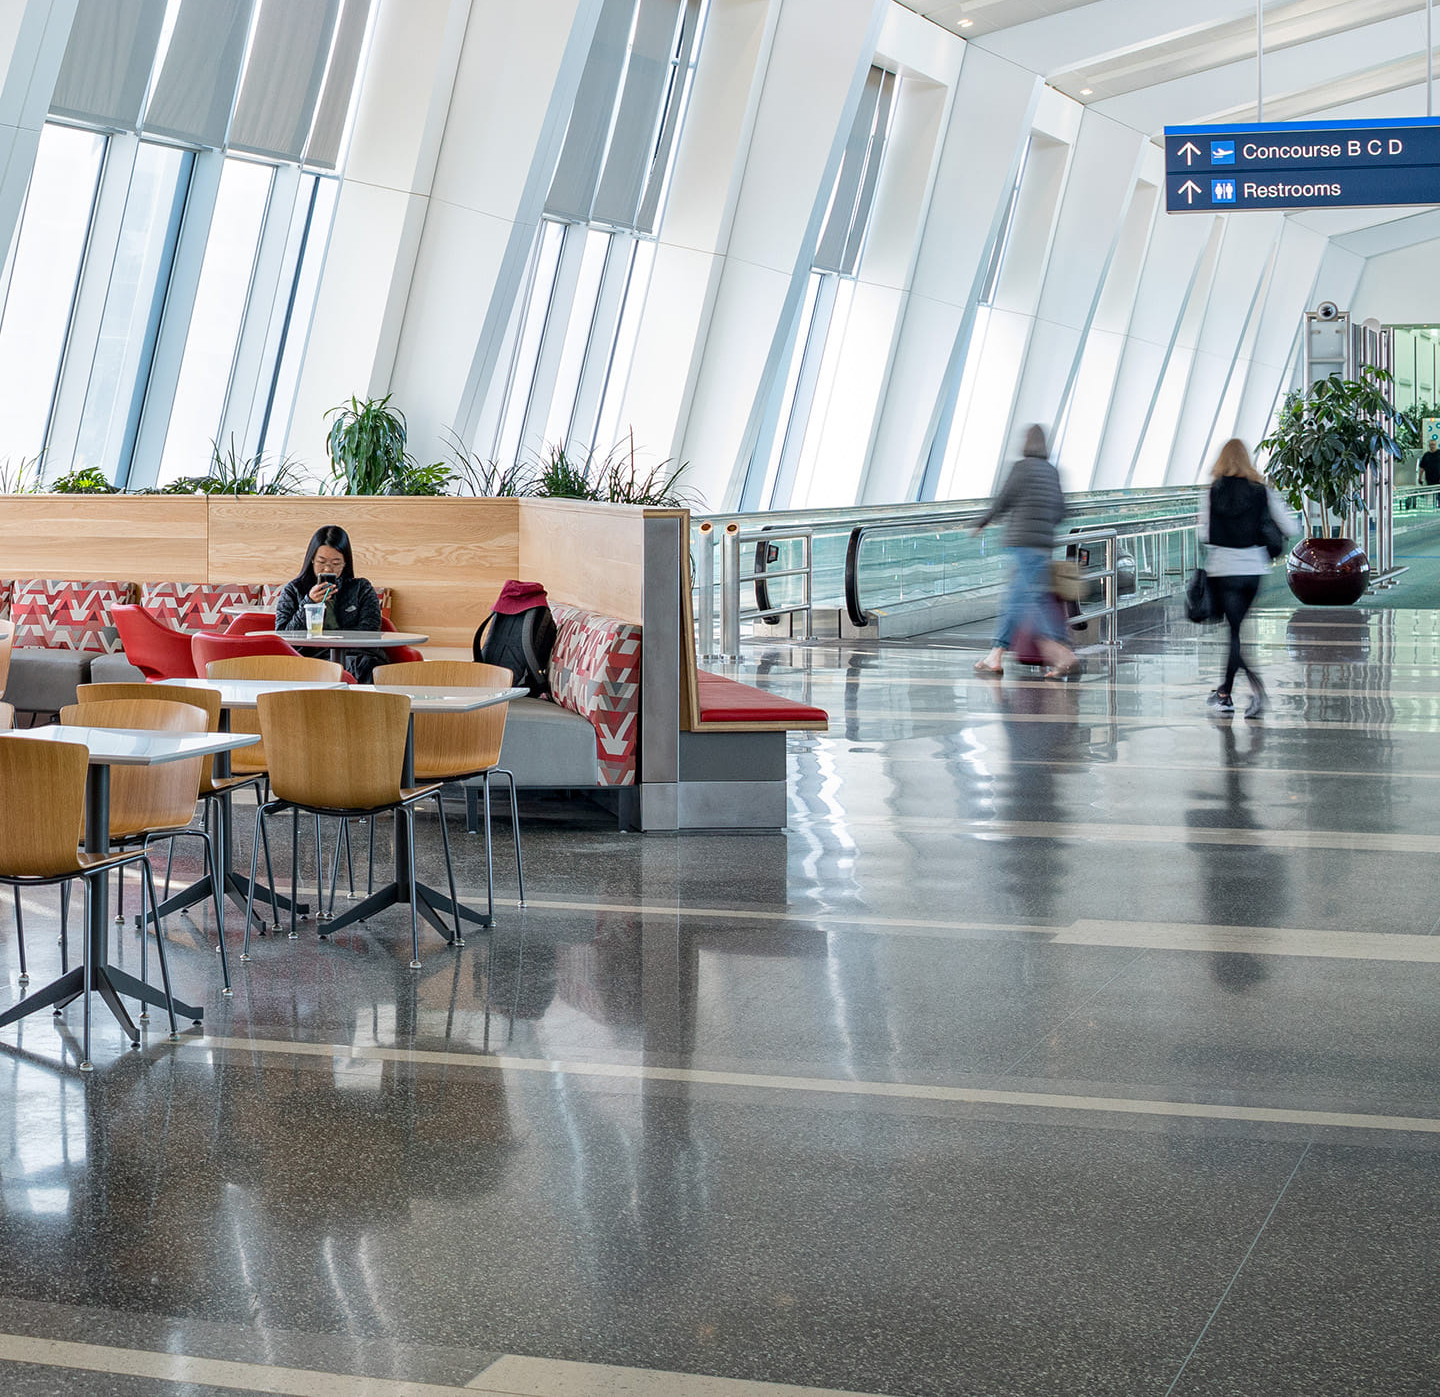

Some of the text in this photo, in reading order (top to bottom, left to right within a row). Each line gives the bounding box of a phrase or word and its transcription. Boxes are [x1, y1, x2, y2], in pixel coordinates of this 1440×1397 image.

[1242, 139, 1403, 160] Concourse B C D
[1243, 182, 1342, 199] Restrooms
